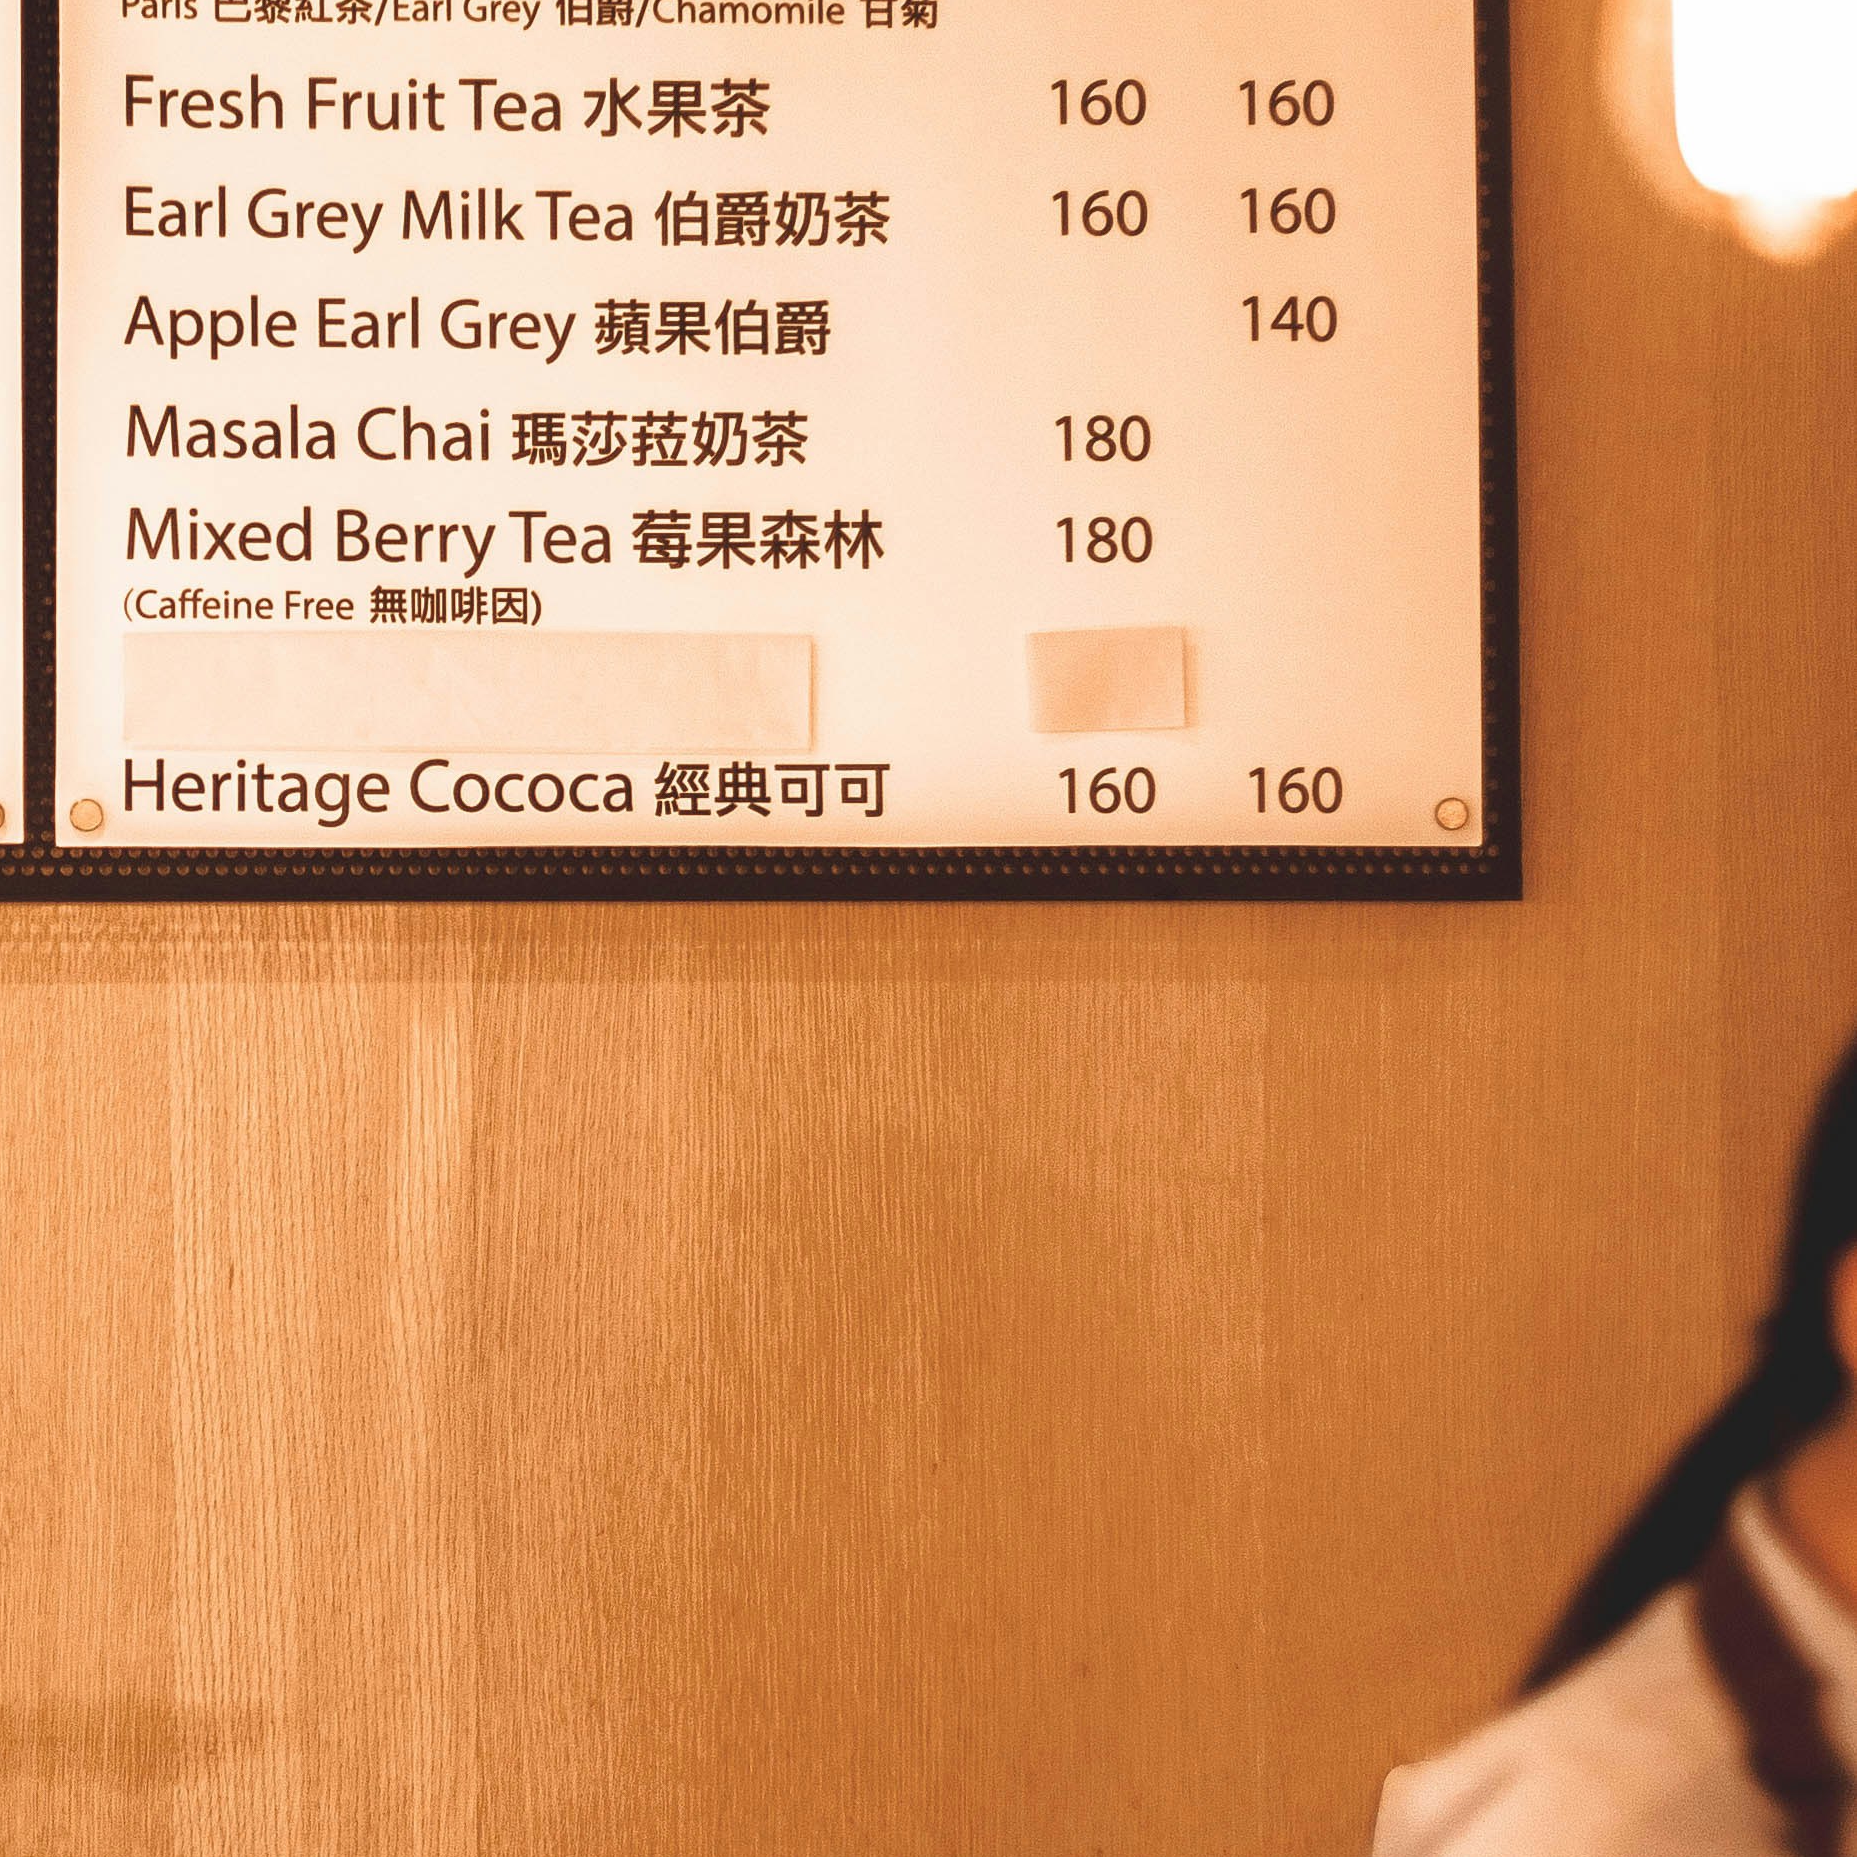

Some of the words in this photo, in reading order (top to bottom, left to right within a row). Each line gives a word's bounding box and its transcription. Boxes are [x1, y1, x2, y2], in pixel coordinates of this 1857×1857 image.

[125, 73, 284, 130] Fresh
[308, 76, 446, 132] Fruit
[458, 78, 562, 133] Tea
[583, 77, 771, 139] 水果茶
[1050, 78, 1147, 127] 160
[1239, 79, 1335, 127] 160
[125, 184, 227, 238] Earl
[247, 187, 384, 255] Grey
[402, 187, 526, 242] Milk
[534, 189, 633, 242] Tea
[654, 189, 891, 248] 伯爵奶茶
[1052, 189, 1148, 237] 160
[1240, 186, 1336, 235] 160
[123, 294, 298, 361] Apple
[318, 295, 420, 349] Earl
[440, 298, 577, 365] Grey
[594, 298, 832, 356] 蘋果伯爵
[1242, 295, 1338, 343] 140
[126, 403, 336, 460] Masala
[357, 404, 490, 462] Chai
[511, 409, 809, 468] 瑪莎菈奶茶
[1054, 414, 1152, 463] 180
[126, 505, 312, 562] Mixed
[336, 508, 497, 580] Berry
[508, 510, 612, 565] Tea
[631, 508, 885, 570] 莓果森林
[1056, 515, 1153, 564] 180
[123, 587, 274, 622] (Caffeine
[285, 590, 355, 621] Free
[369, 584, 542, 627] 無咖啡因)
[124, 757, 391, 828] Heritage
[409, 758, 634, 814] Cococa
[653, 760, 891, 818] 經典可可
[1058, 766, 1156, 815] 160
[1248, 766, 1343, 815] 160
